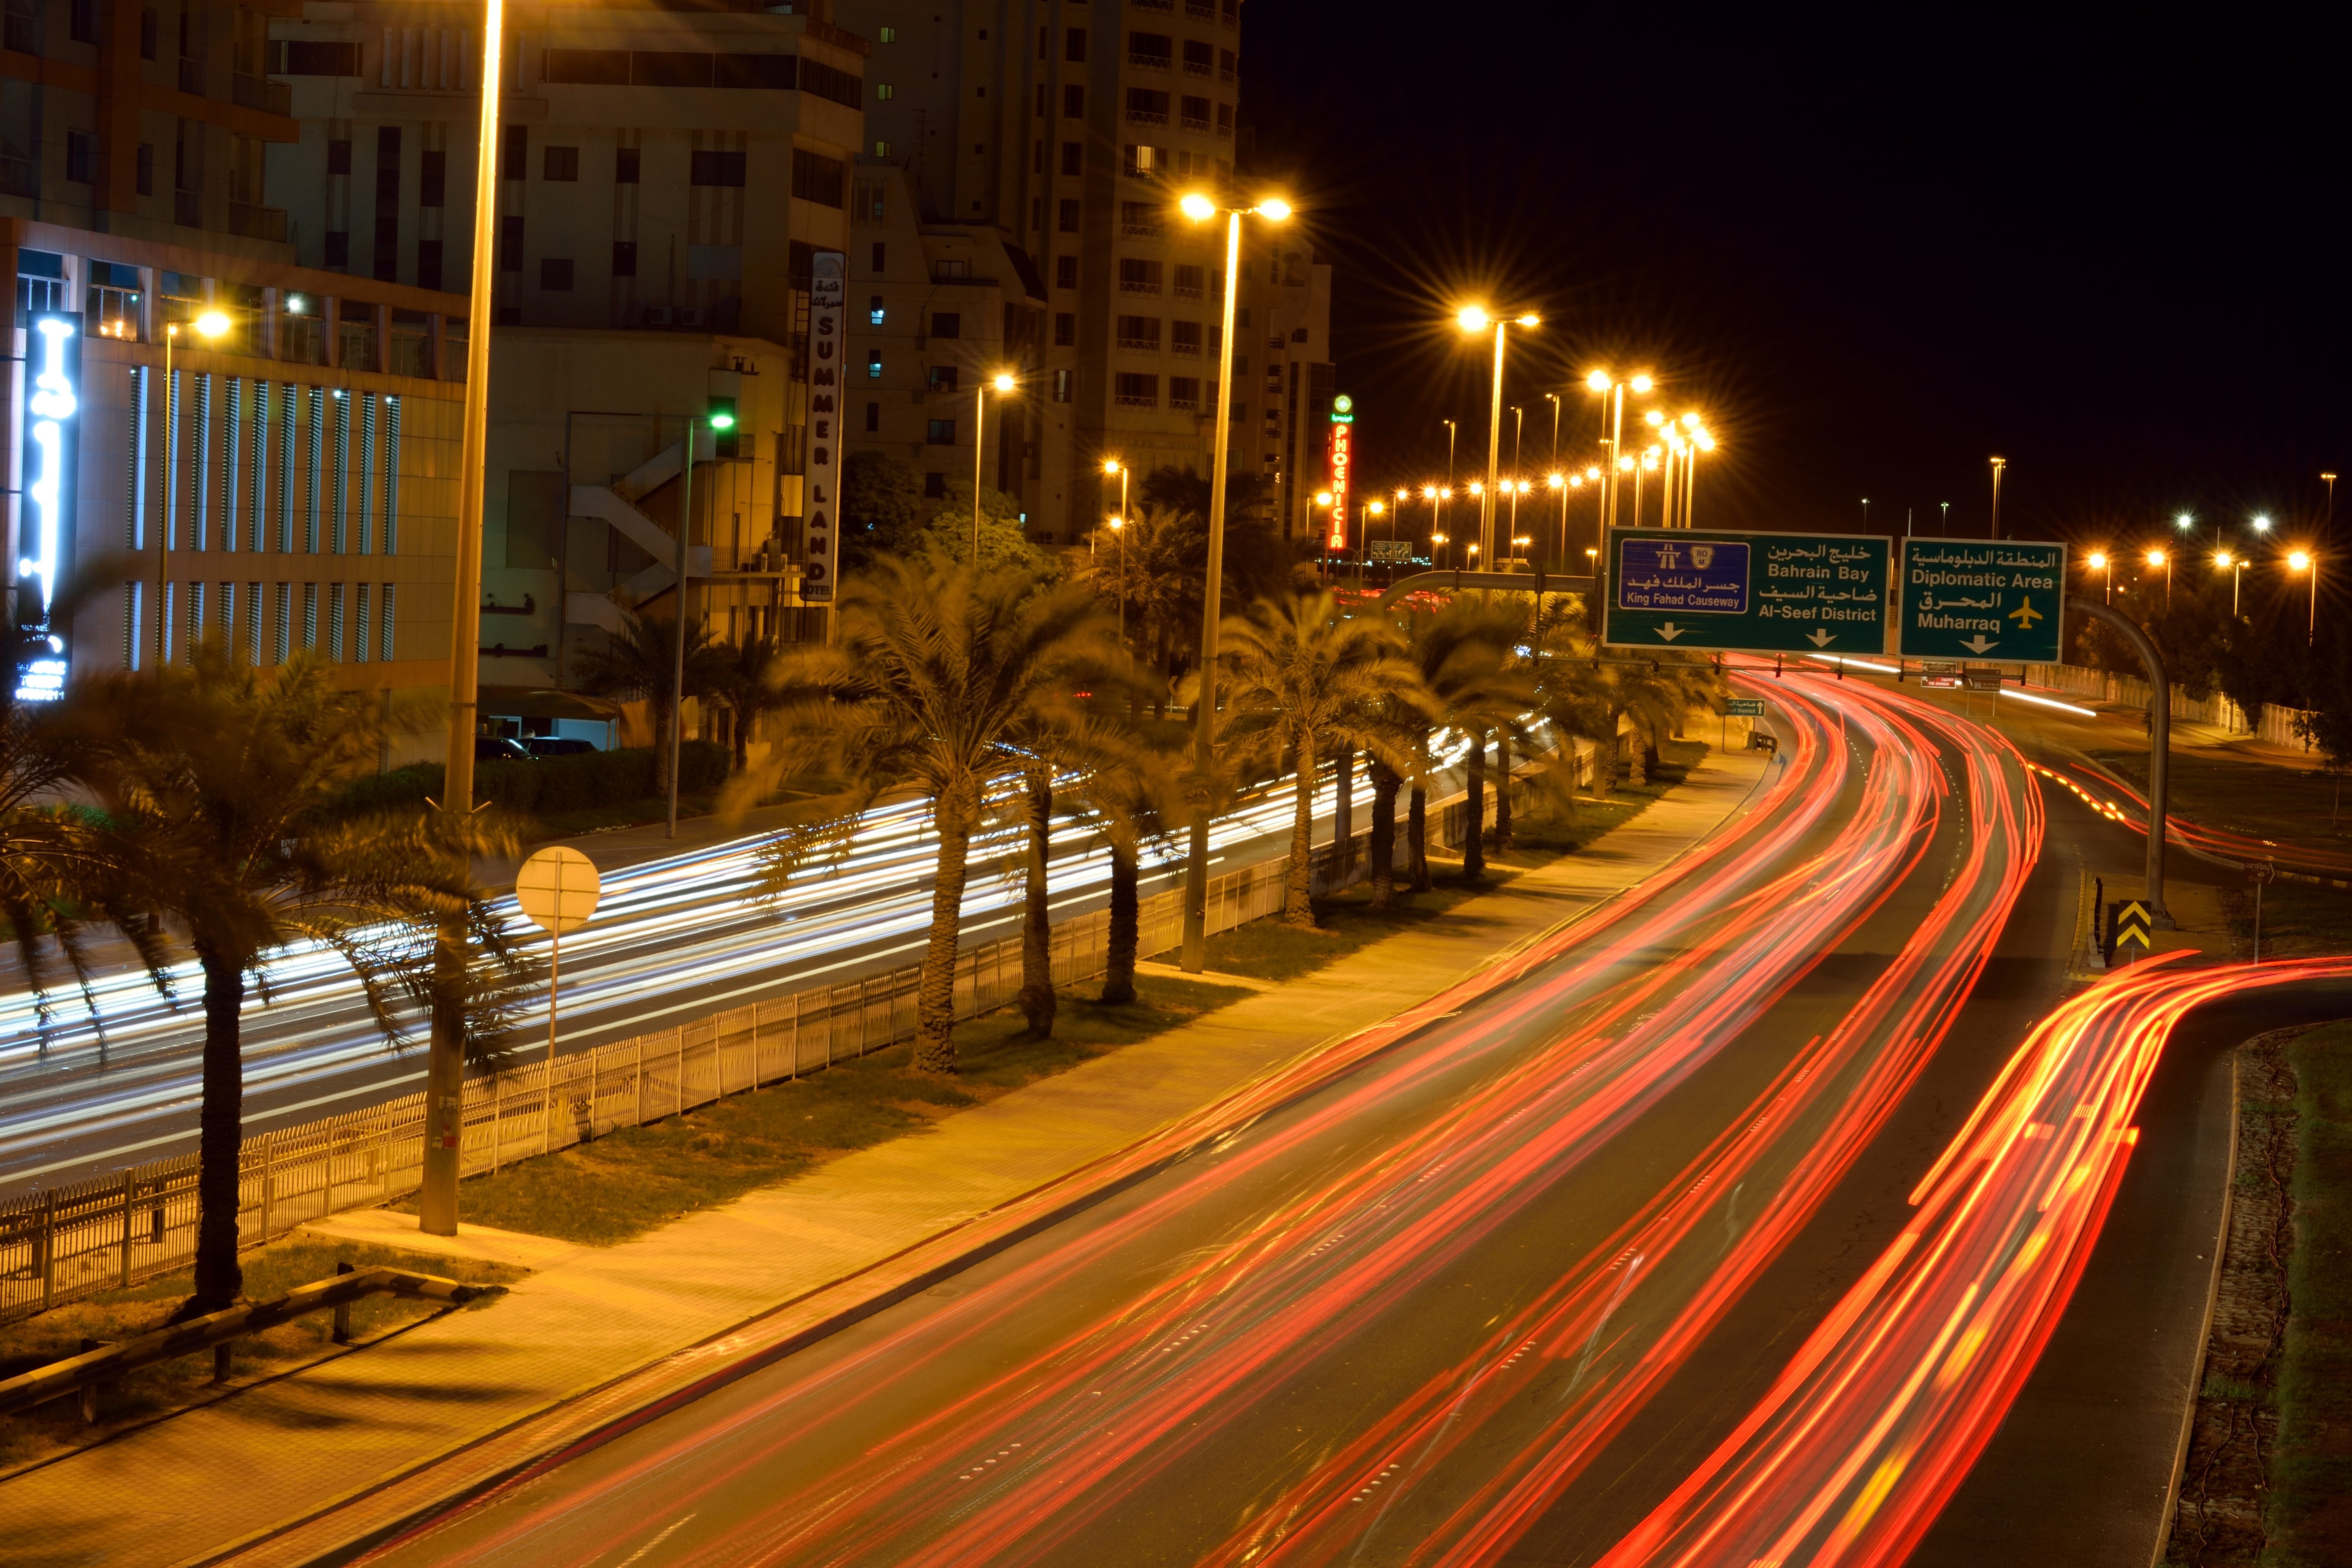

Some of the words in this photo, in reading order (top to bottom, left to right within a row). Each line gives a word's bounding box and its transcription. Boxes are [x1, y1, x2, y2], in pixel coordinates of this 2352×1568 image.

[812, 316, 834, 466] SUMMER
[1331, 425, 1347, 548] PHOENICIA
[808, 485, 828, 581] LAND
[1768, 544, 1826, 561] البحرين
[1829, 545, 1871, 564] خليج
[1912, 547, 1994, 568] الدبلوماسية
[1996, 550, 2055, 568] المنطقة
[1627, 574, 1660, 590] فهد
[1768, 564, 1830, 579] Bahrain
[1838, 566, 1870, 583] Bay
[1912, 569, 2006, 587] Diplomatic
[2012, 573, 2053, 589] Area
[1662, 576, 1702, 590] الملك
[1702, 582, 1740, 593] جسر
[1627, 592, 1649, 606] King
[1654, 593, 1684, 604] Fahad
[1688, 594, 1739, 609] Causeway
[1759, 585, 1814, 602] السيف
[1817, 586, 1877, 603] ضاحية
[1918, 591, 2002, 610] المحرق
[1759, 604, 1817, 619] Al-Seef
[1822, 606, 1876, 621] District
[1917, 613, 2001, 634] Muharraq
